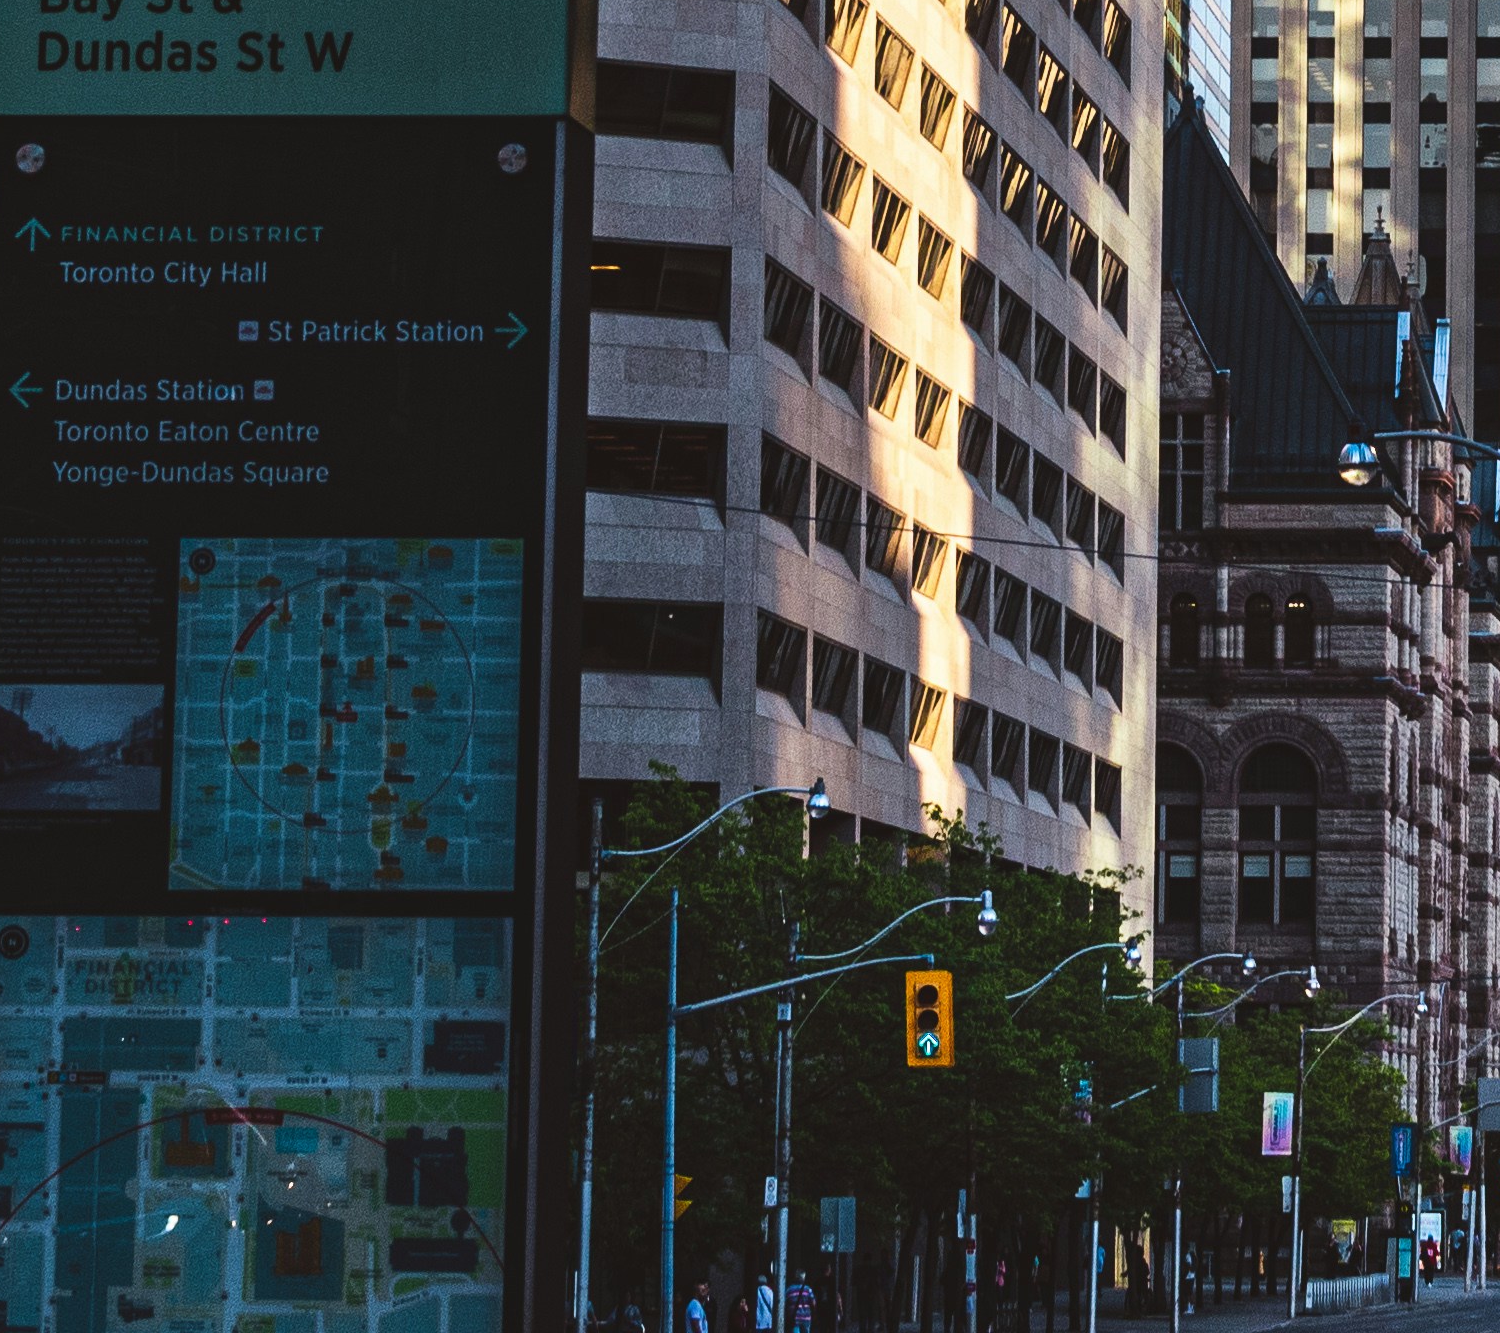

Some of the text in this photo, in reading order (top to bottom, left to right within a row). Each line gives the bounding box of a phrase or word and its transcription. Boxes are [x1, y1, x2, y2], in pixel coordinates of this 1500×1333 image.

[36, 30, 354, 72] Dundas St W
[60, 225, 325, 243] FINANCIAL DISTRICT
[60, 261, 268, 288] Toronto City Hall
[267, 320, 484, 343] St Patrick Station
[54, 378, 245, 402] Dundas Station
[54, 420, 320, 443] Toronto Eaton Centre
[52, 461, 330, 487] Yonge-Dundas Square
[75, 960, 192, 976] FINANCIAL
[84, 978, 182, 995] DISTRICT
